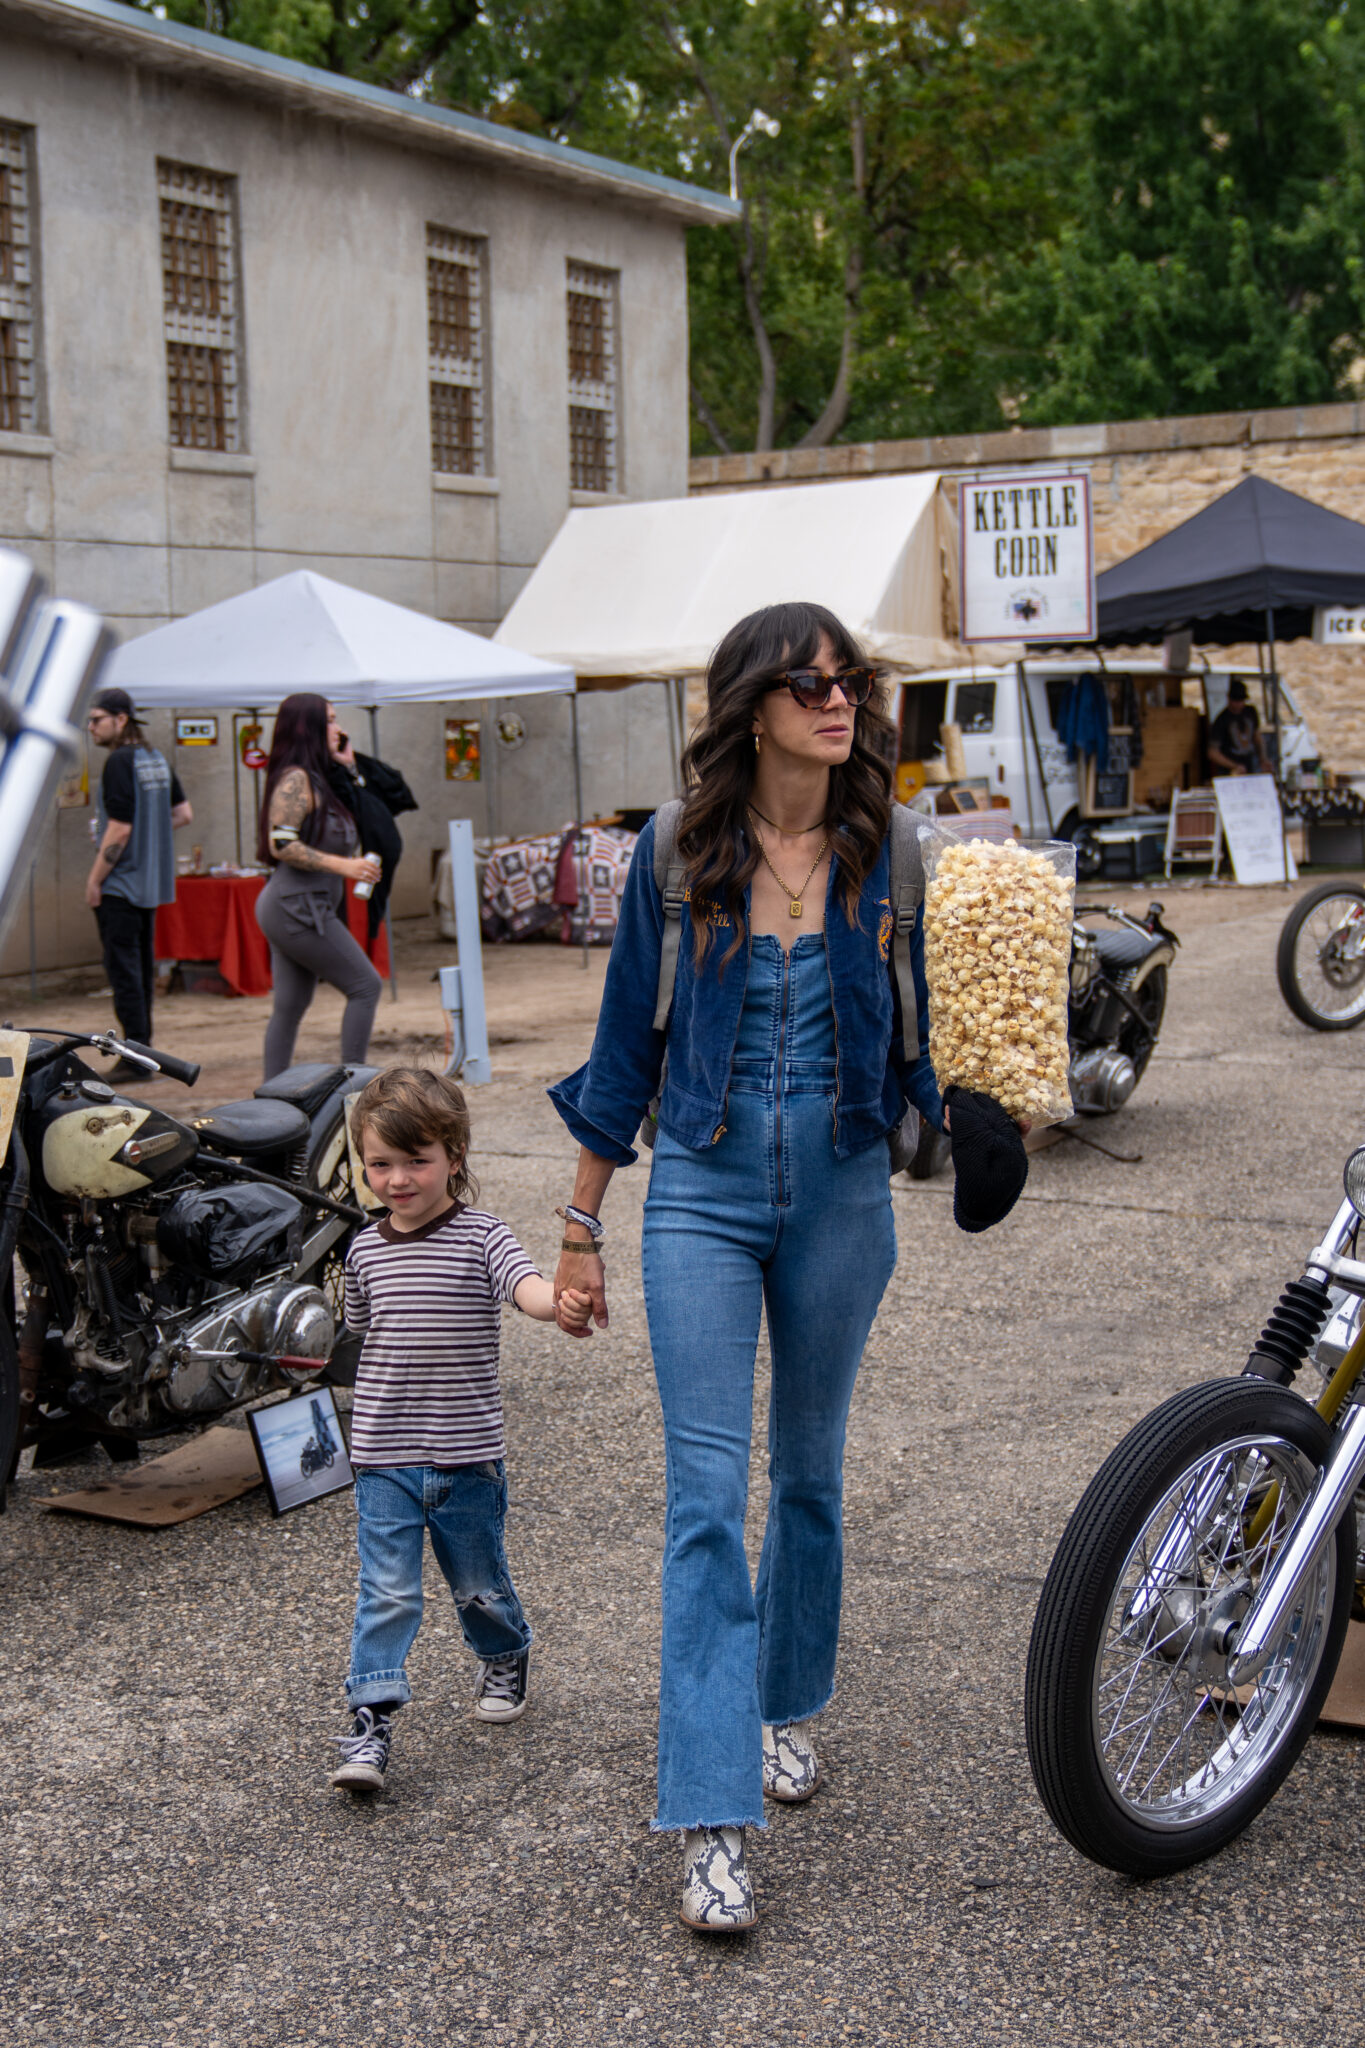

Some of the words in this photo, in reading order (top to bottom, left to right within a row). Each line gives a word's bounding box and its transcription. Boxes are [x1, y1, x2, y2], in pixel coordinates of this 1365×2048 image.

[974, 486, 1077, 532] KETTLE
[995, 534, 1057, 578] CORN
[1329, 617, 1355, 633] ICE
